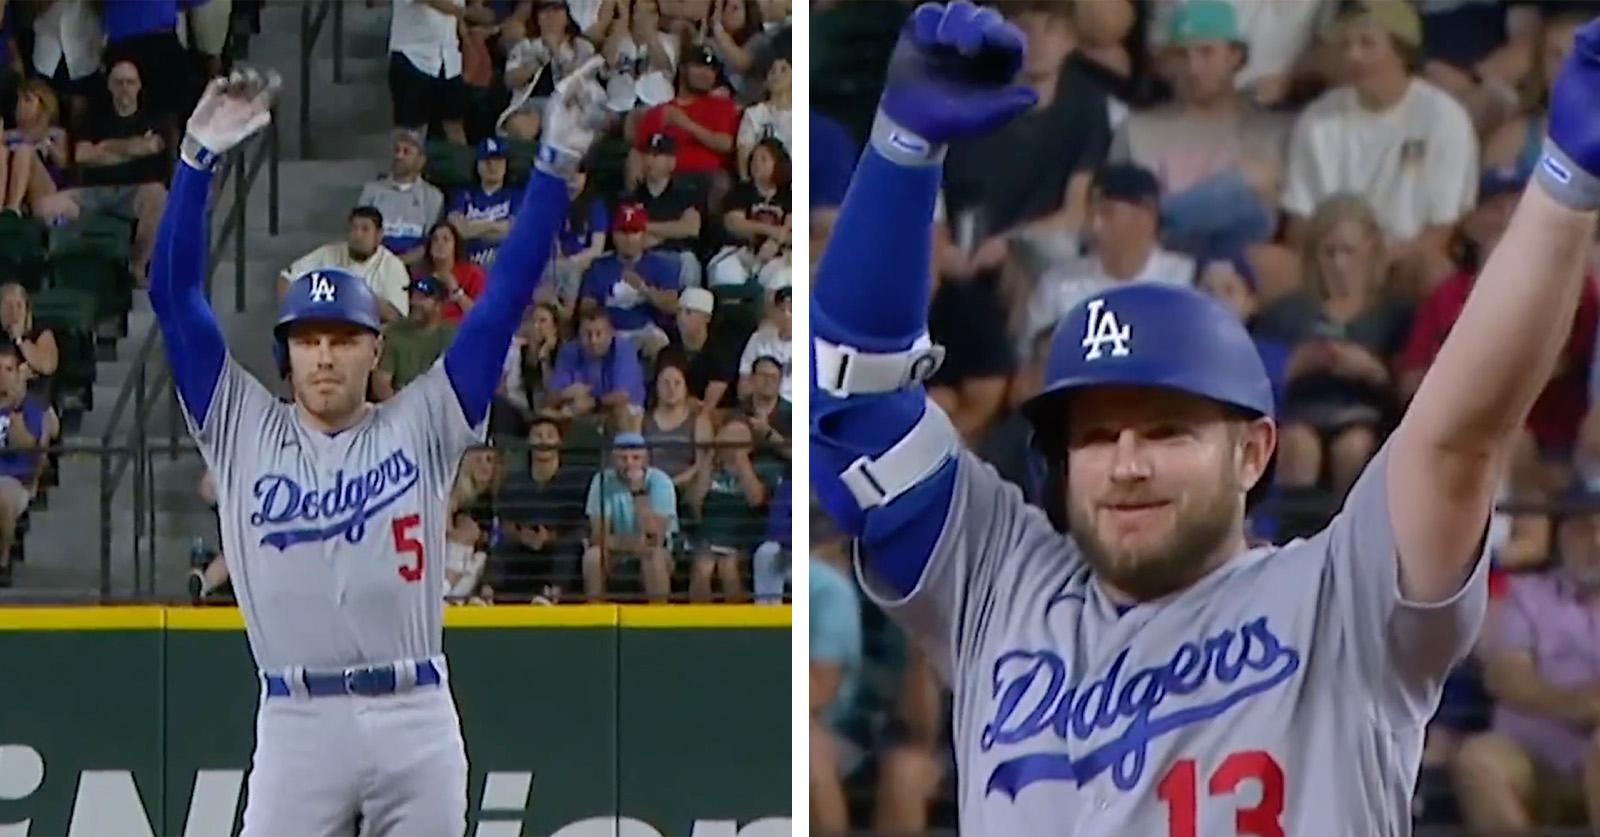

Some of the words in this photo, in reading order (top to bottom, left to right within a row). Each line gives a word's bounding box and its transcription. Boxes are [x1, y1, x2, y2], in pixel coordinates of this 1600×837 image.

[311, 272, 335, 302] LA
[1082, 299, 1131, 361] LA
[251, 449, 419, 545] Dodgers
[392, 513, 423, 582] 5
[1156, 750, 1286, 837] 13
